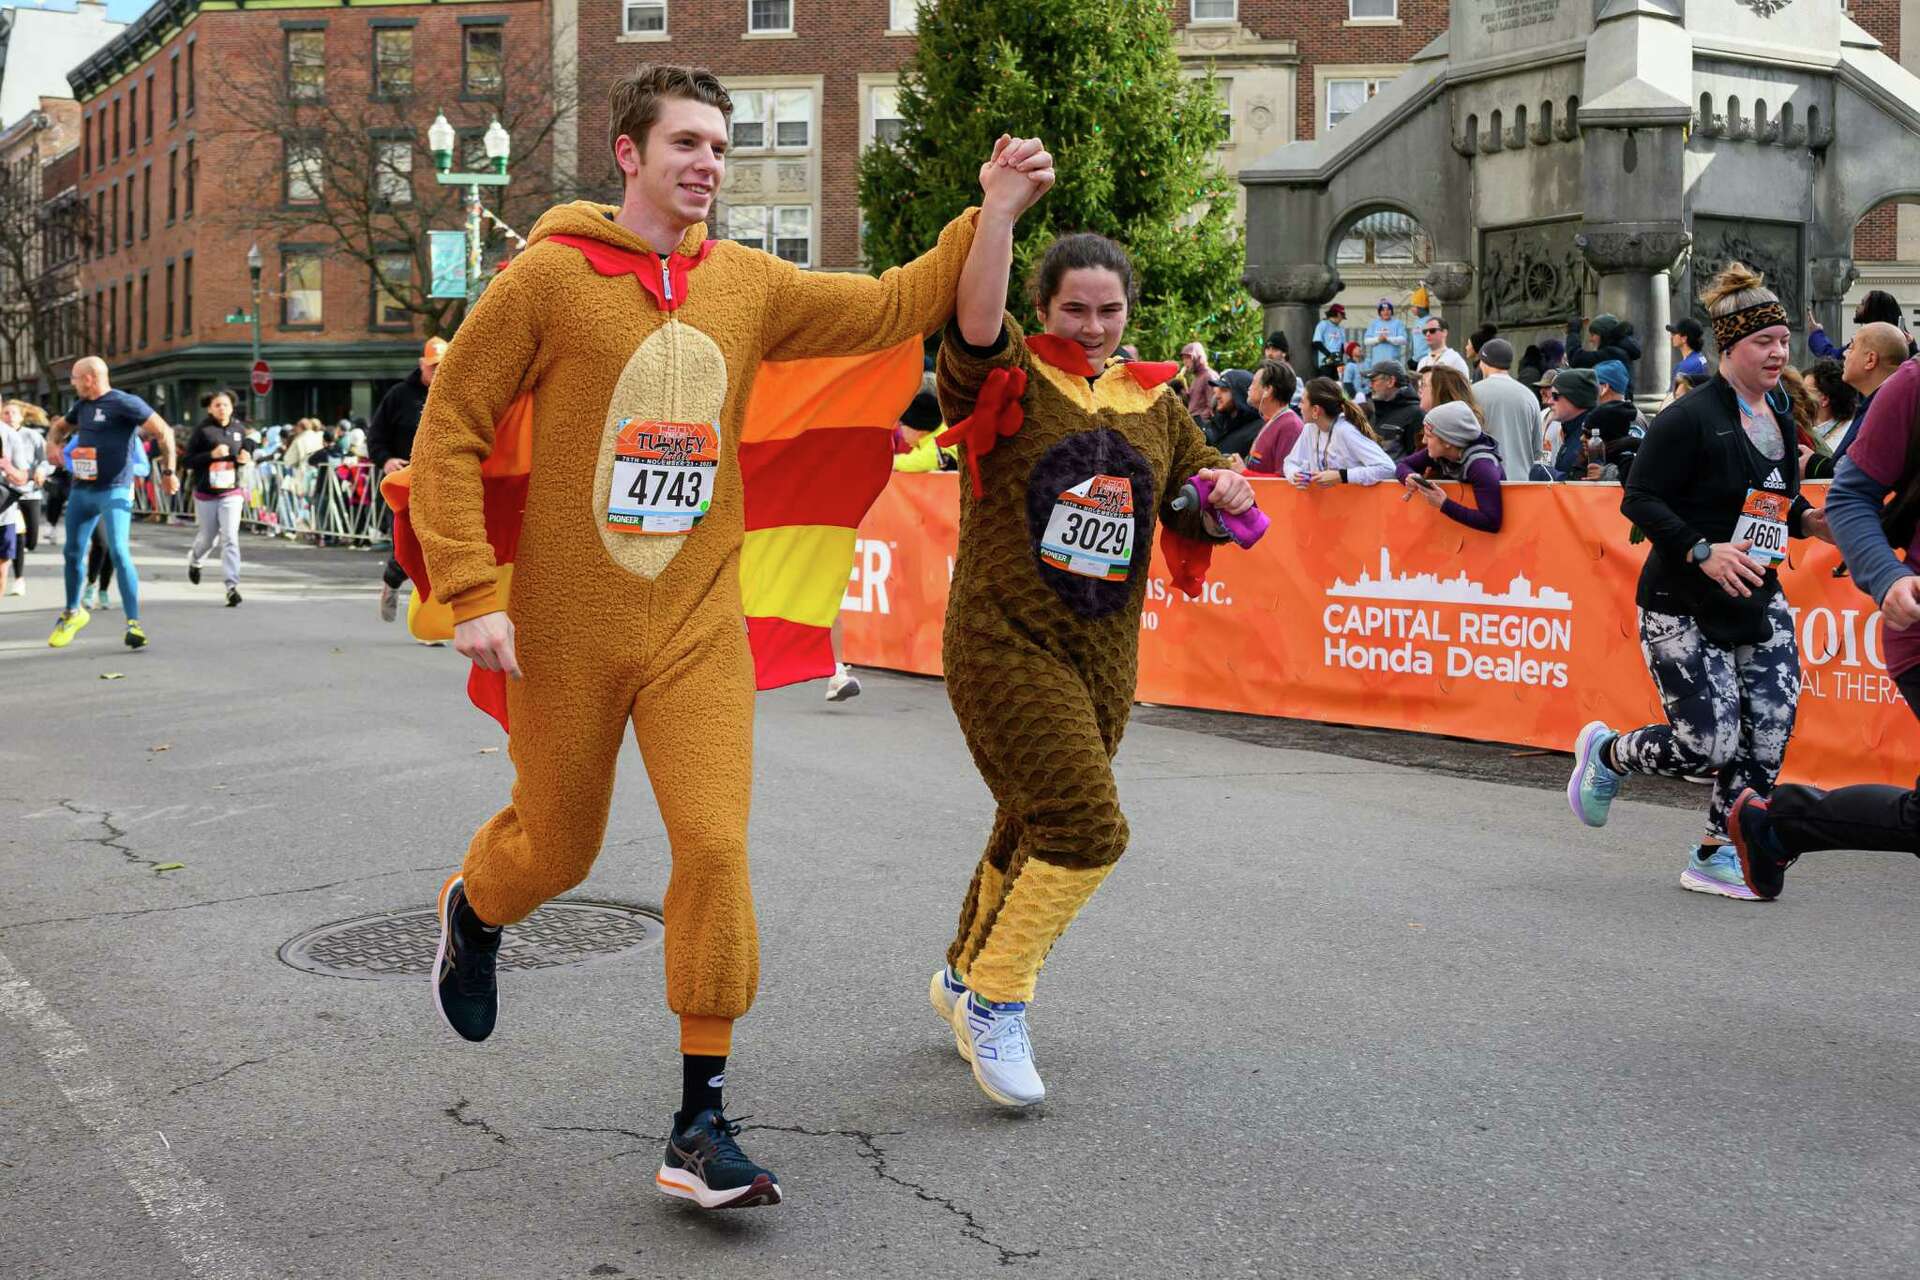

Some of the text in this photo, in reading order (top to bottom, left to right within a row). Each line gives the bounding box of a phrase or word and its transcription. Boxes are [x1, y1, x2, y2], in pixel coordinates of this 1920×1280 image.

[638, 433, 706, 453] TURKEY
[628, 469, 703, 507] 4743
[1763, 481, 1786, 490] adidas
[608, 514, 639, 524] PIONEER
[1061, 513, 1128, 555] 3029
[1743, 522, 1782, 550] 4660
[1041, 549, 1067, 562] PIONEER
[1323, 604, 1571, 652] CAPITAL REGION
[1324, 637, 1569, 688] Honda Dealers
